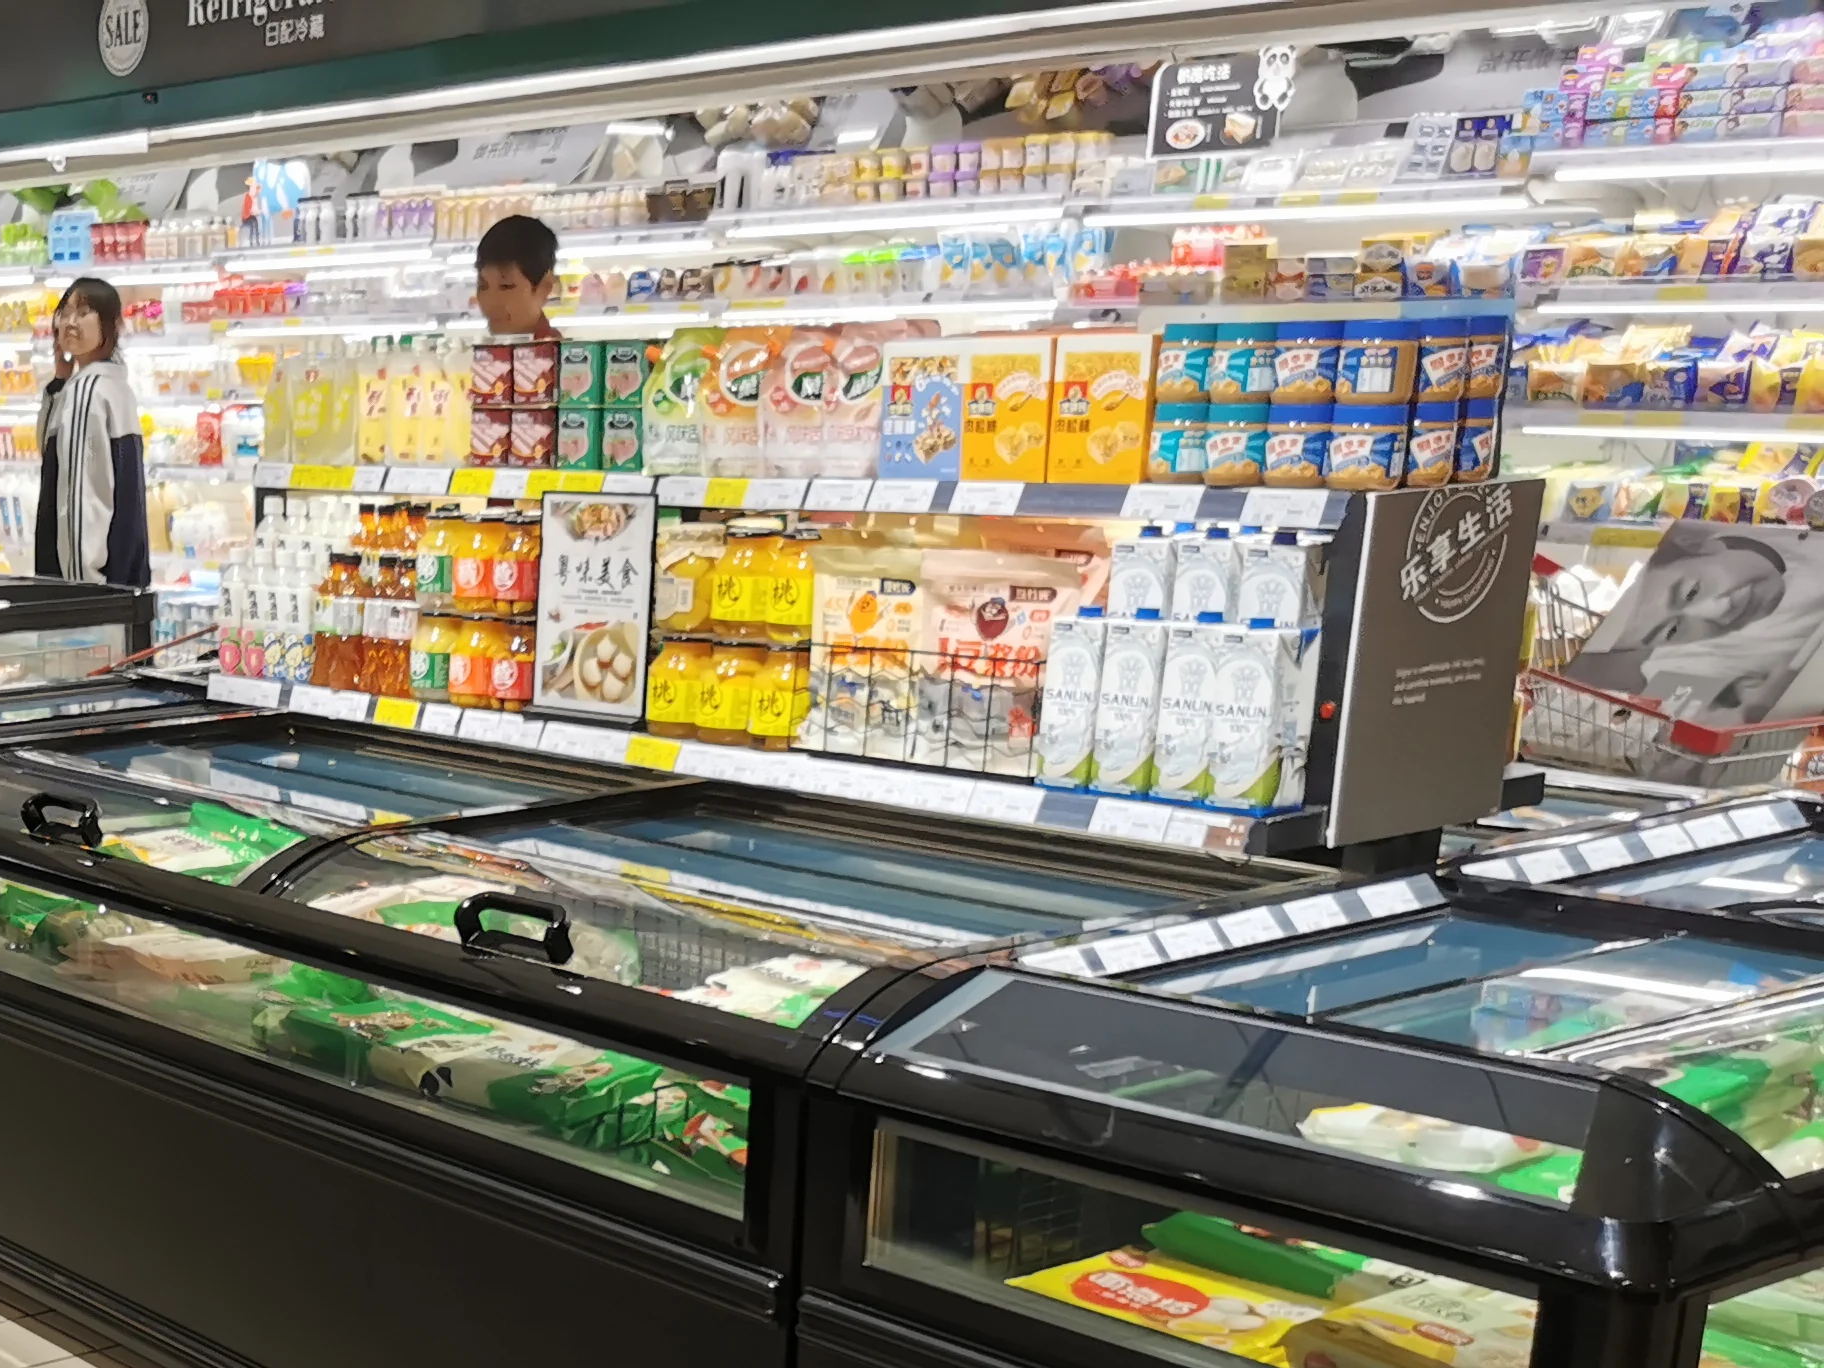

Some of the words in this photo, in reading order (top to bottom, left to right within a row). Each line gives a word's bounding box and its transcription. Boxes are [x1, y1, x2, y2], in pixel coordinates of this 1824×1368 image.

[105, 9, 142, 48] SALE
[1400, 484, 1513, 601] 乐享生活
[555, 554, 640, 589] 粤味美食
